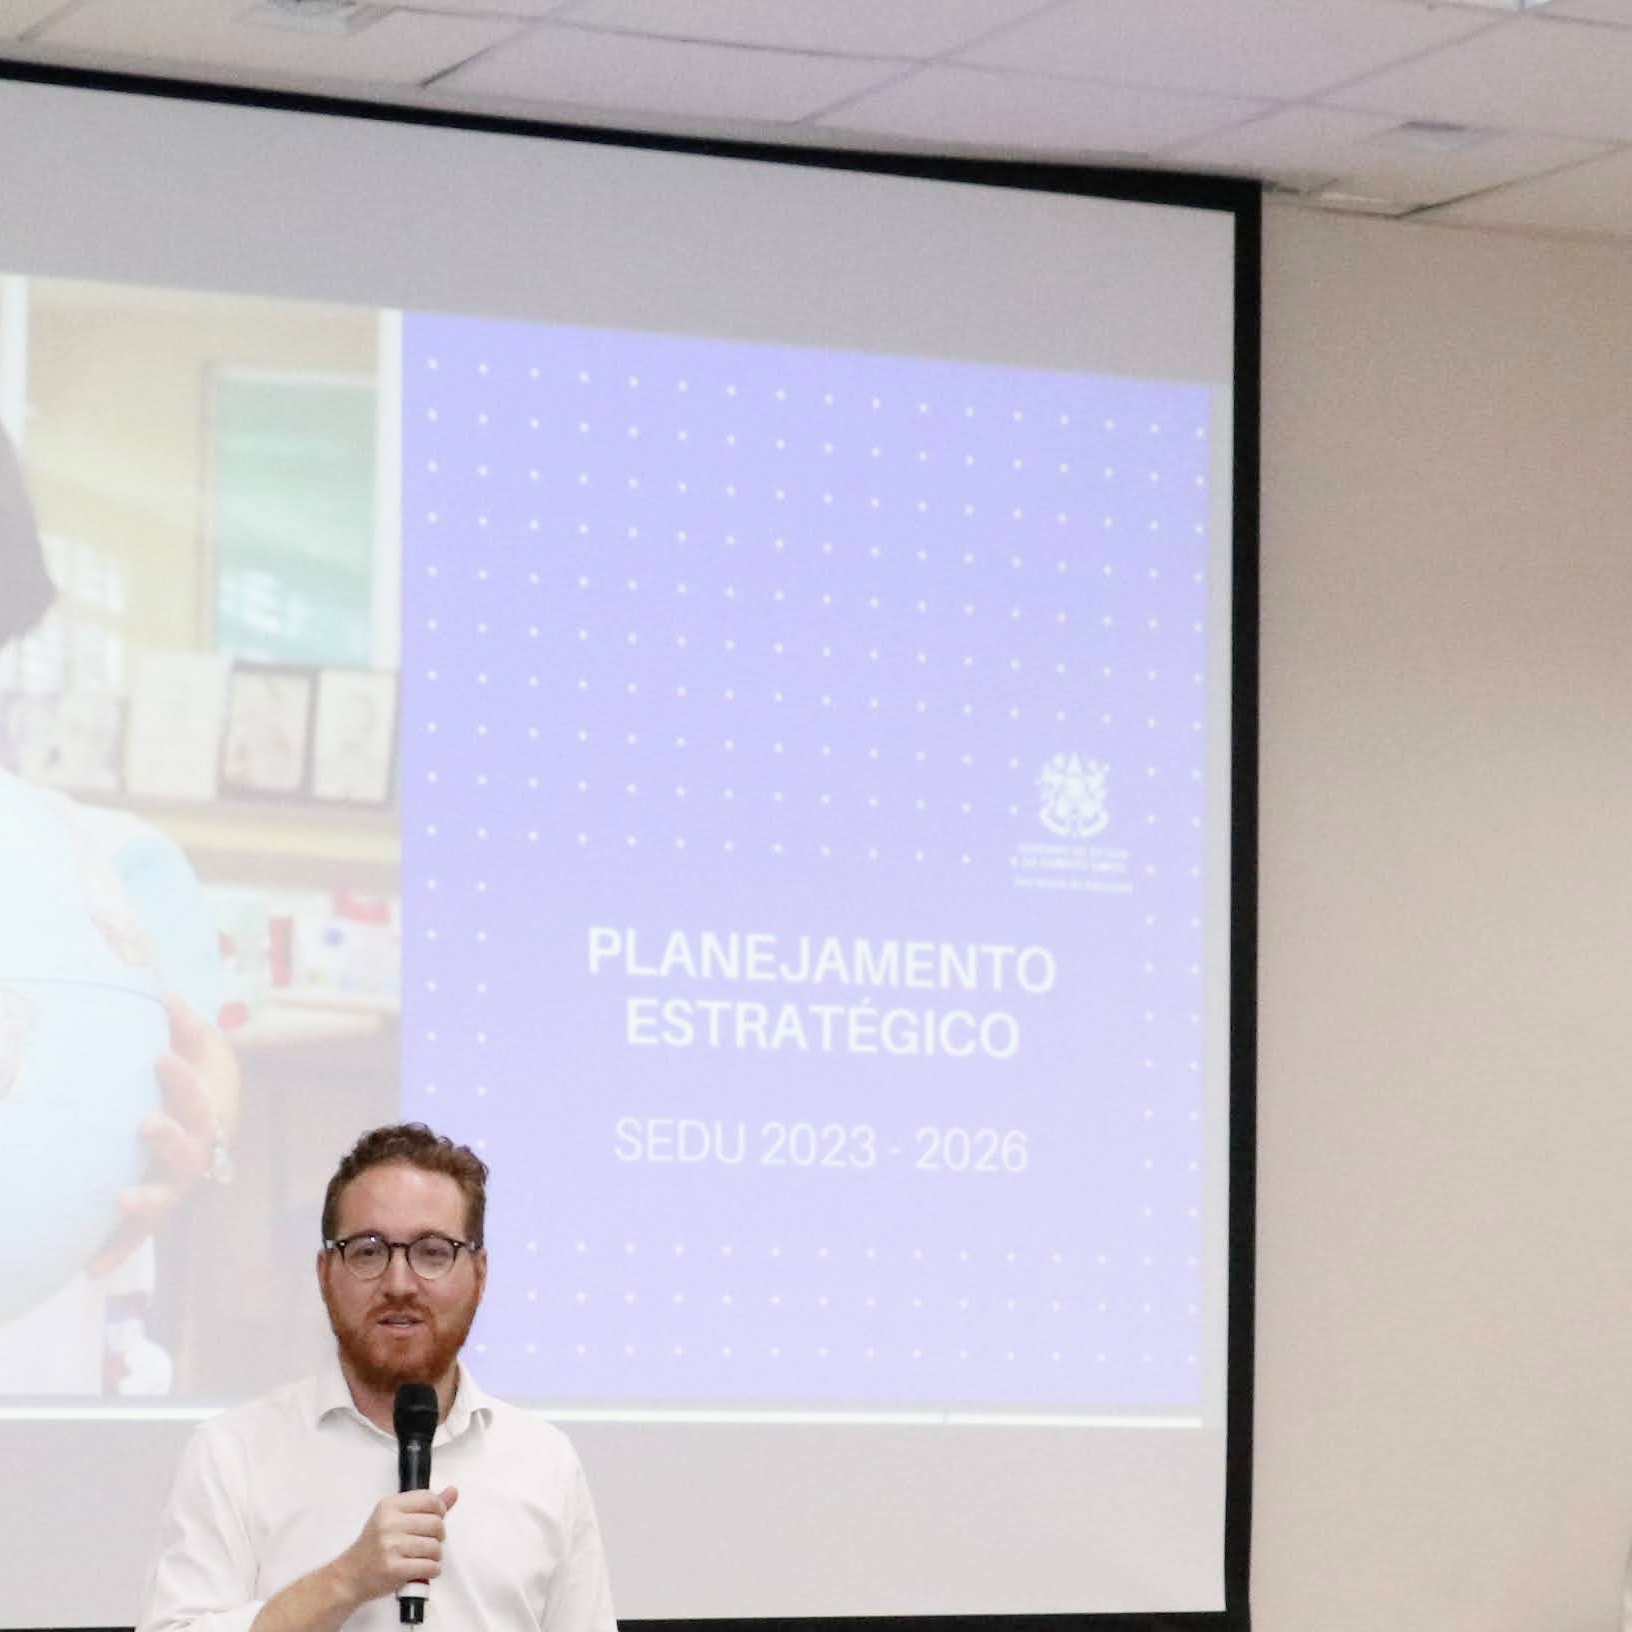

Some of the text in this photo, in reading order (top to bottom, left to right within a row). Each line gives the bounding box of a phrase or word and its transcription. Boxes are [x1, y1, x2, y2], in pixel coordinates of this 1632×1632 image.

[587, 925, 1057, 994] PLANEJAMENTO
[626, 996, 1020, 1059] ESTRATÉGICO
[613, 1117, 747, 1164] SEDU
[760, 1121, 878, 1169] 2023
[914, 1125, 1029, 1174] 2026
